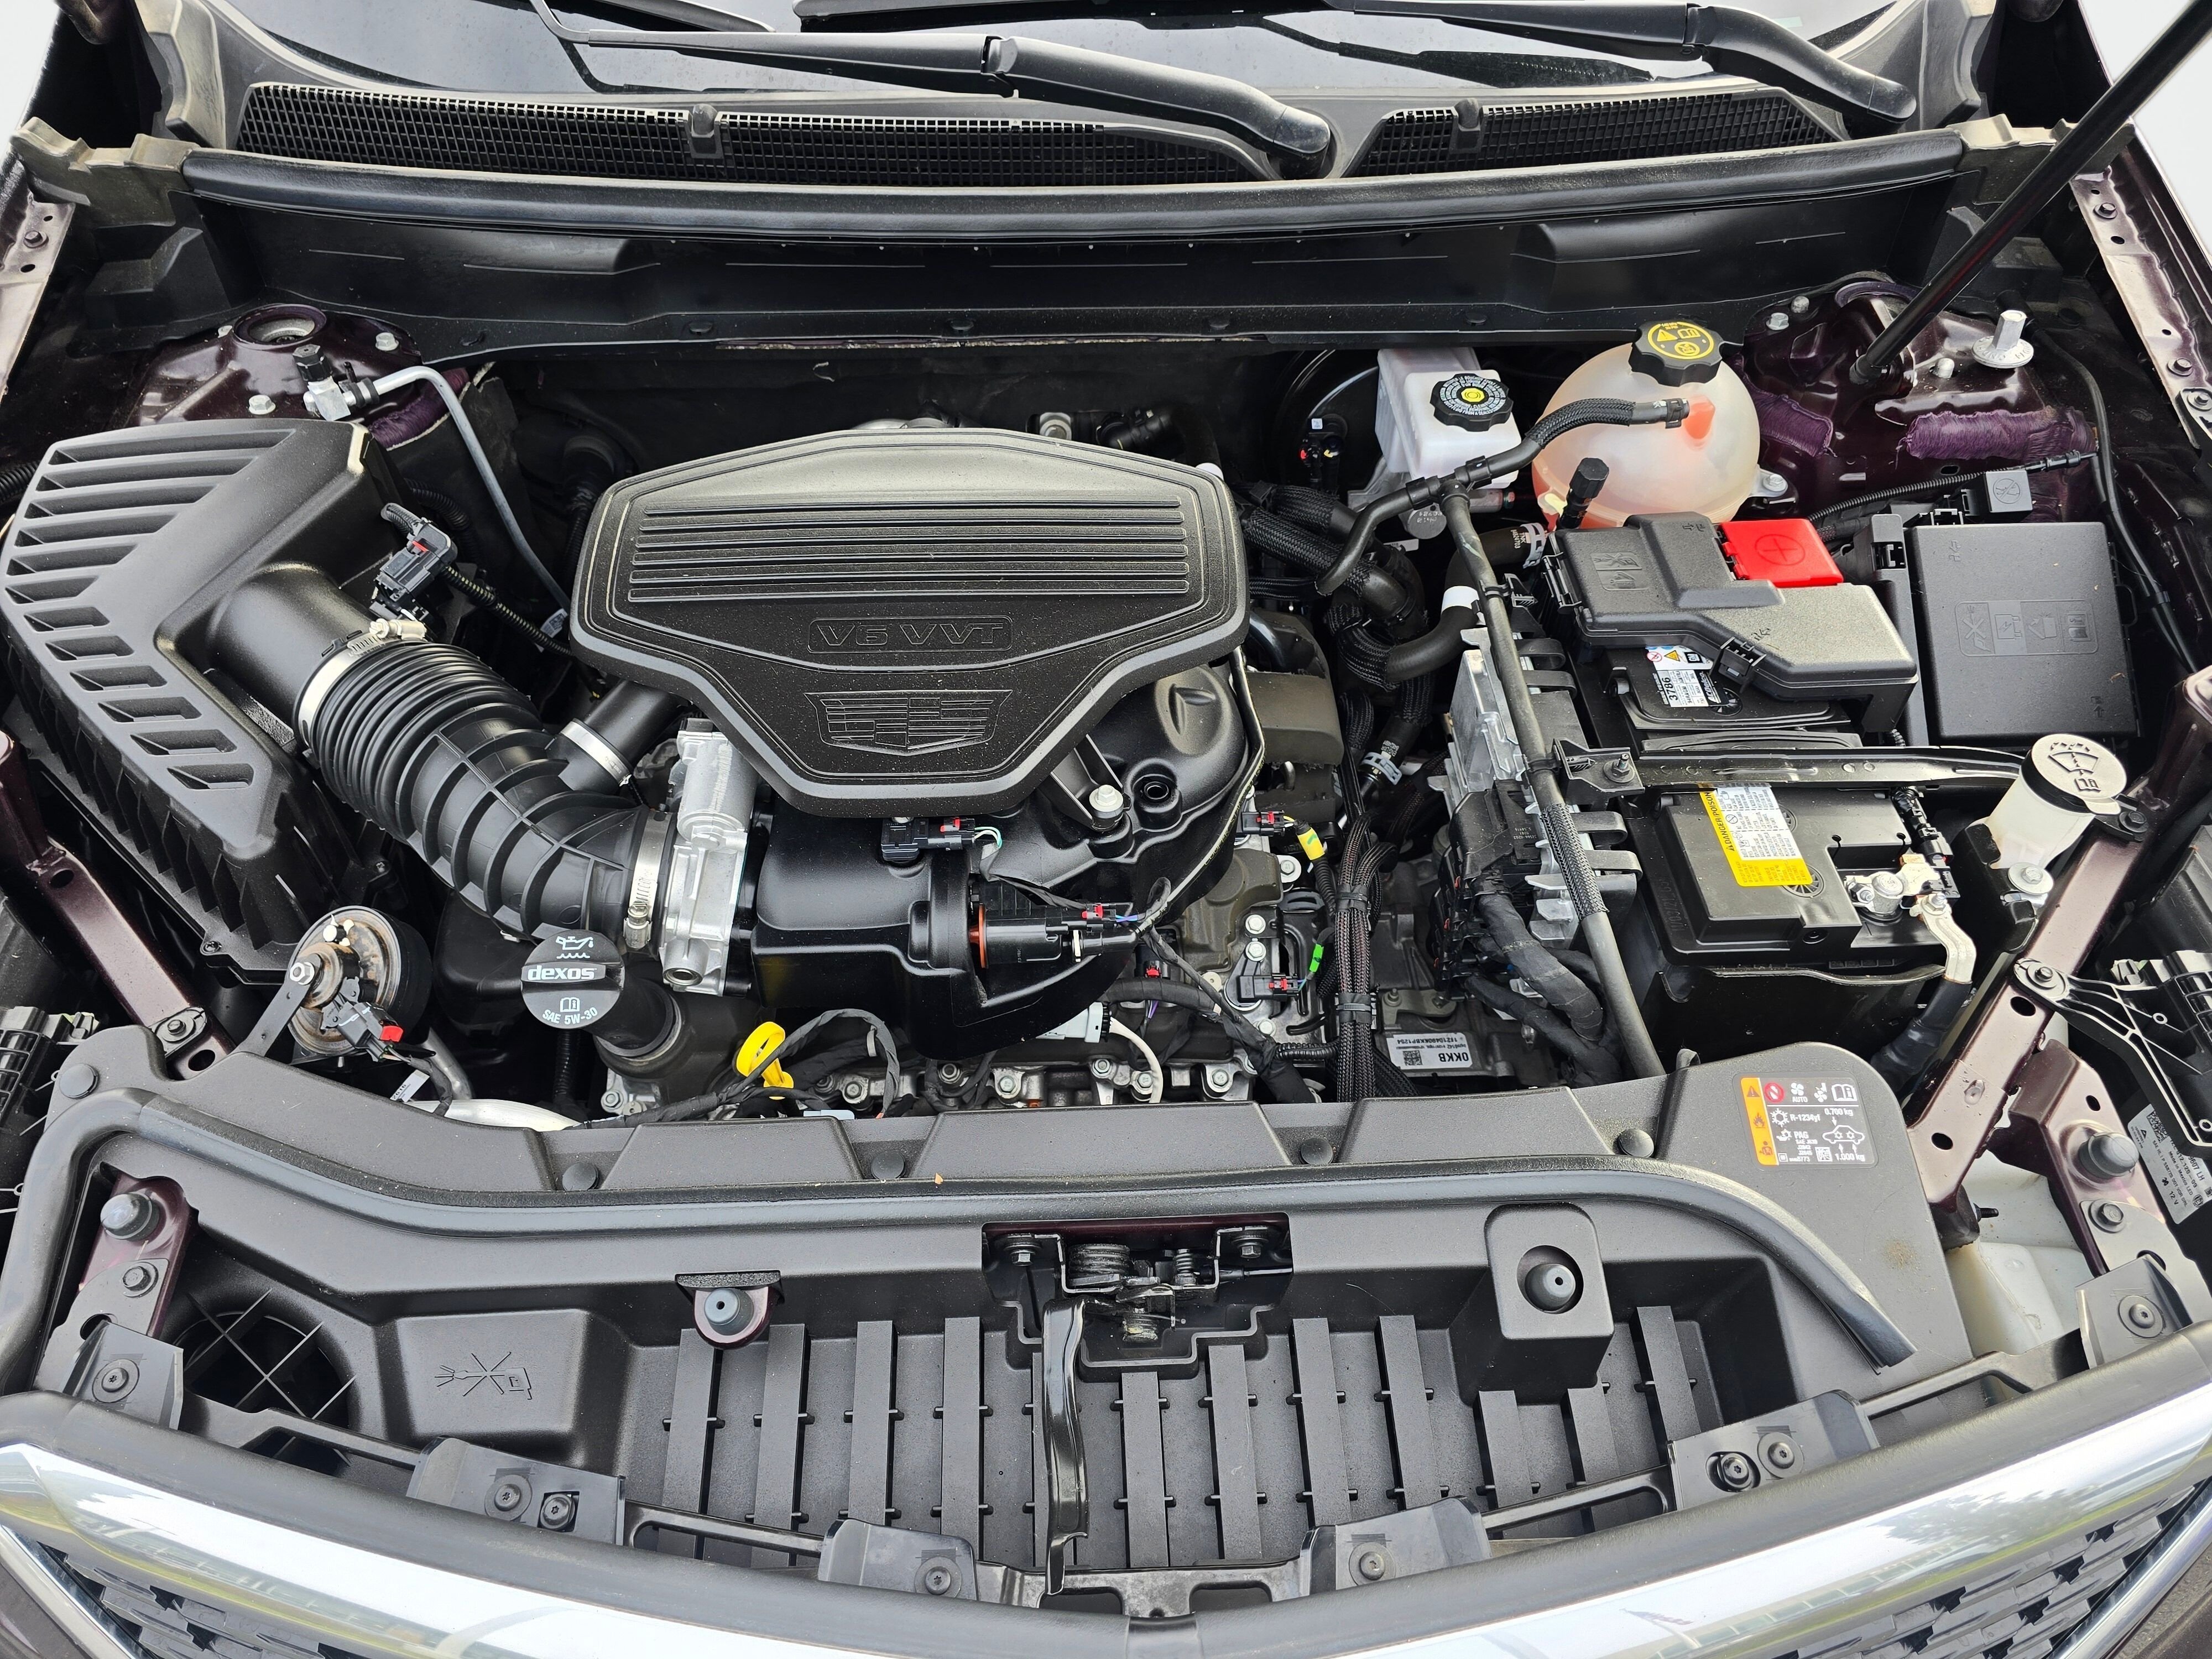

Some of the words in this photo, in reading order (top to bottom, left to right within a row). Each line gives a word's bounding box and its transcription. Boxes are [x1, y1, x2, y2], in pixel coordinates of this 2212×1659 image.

[817, 625, 888, 646] V6
[900, 623, 1003, 645] VVT
[1662, 677, 1678, 701] 3786
[528, 965, 594, 980] dexos
[542, 1009, 561, 1024] SAE
[564, 1007, 598, 1025] 5W-30
[1844, 1108, 1854, 1117] kg
[1790, 1113, 1820, 1123] R-1234yf
[1793, 1131, 1809, 1139] PAG
[1855, 1154, 1865, 1162] kg
[2178, 1169, 2188, 1186] Mexico
[2196, 1171, 2205, 1181] LH
[2169, 1191, 2176, 1199] 12
